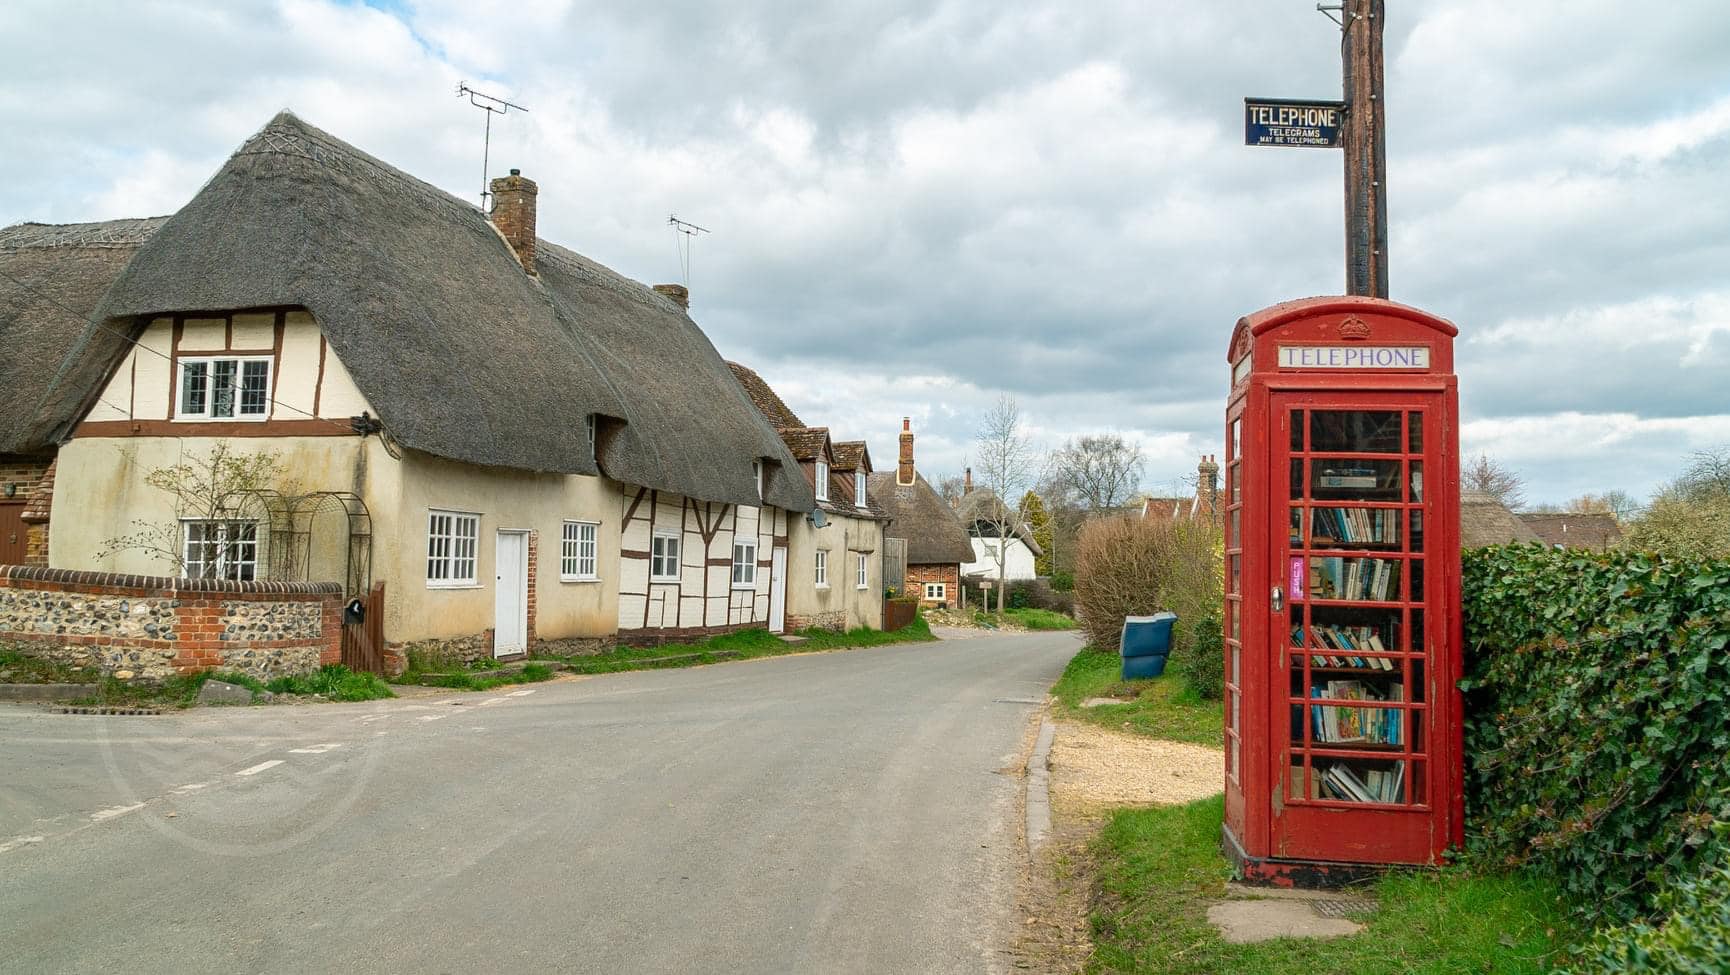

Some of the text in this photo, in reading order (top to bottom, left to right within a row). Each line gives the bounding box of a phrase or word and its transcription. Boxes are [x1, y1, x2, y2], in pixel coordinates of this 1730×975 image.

[1249, 107, 1336, 127] TELEPHONE
[1268, 128, 1320, 137] TELEGRAMS
[1287, 137, 1328, 145] TELEPHONED
[1283, 348, 1422, 366] TELEPHONE
